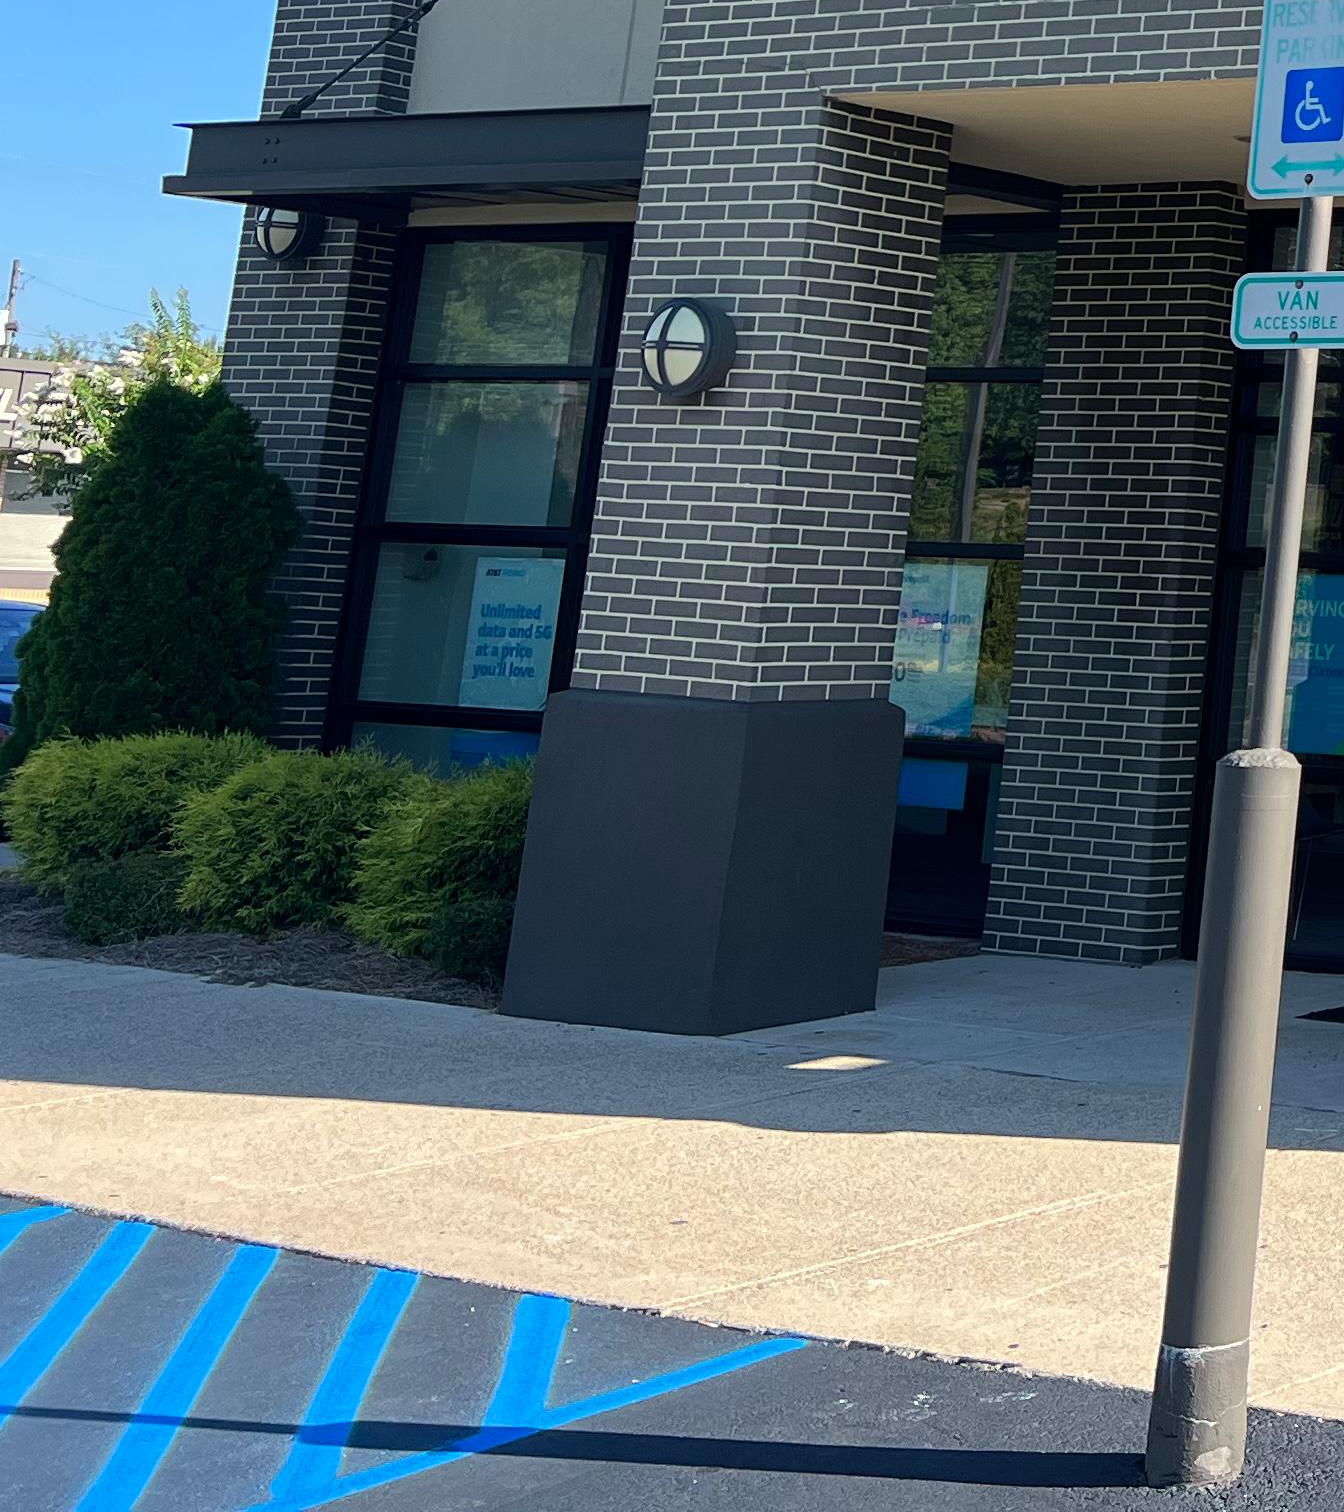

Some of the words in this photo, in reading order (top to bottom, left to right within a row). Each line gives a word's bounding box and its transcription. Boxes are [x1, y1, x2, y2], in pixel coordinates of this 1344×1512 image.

[1278, 290, 1319, 311] VAN
[1253, 316, 1339, 330] ACCESSIBLE
[480, 604, 542, 620] Unlimited
[911, 608, 972, 626] Freedom
[478, 622, 507, 639] data
[508, 623, 533, 639] and
[534, 625, 553, 639] 5G
[475, 643, 489, 657] at
[490, 647, 499, 657] a
[501, 643, 533, 663] price
[1291, 641, 1336, 661] FELY
[472, 662, 506, 680] you'll
[509, 662, 535, 678] love
